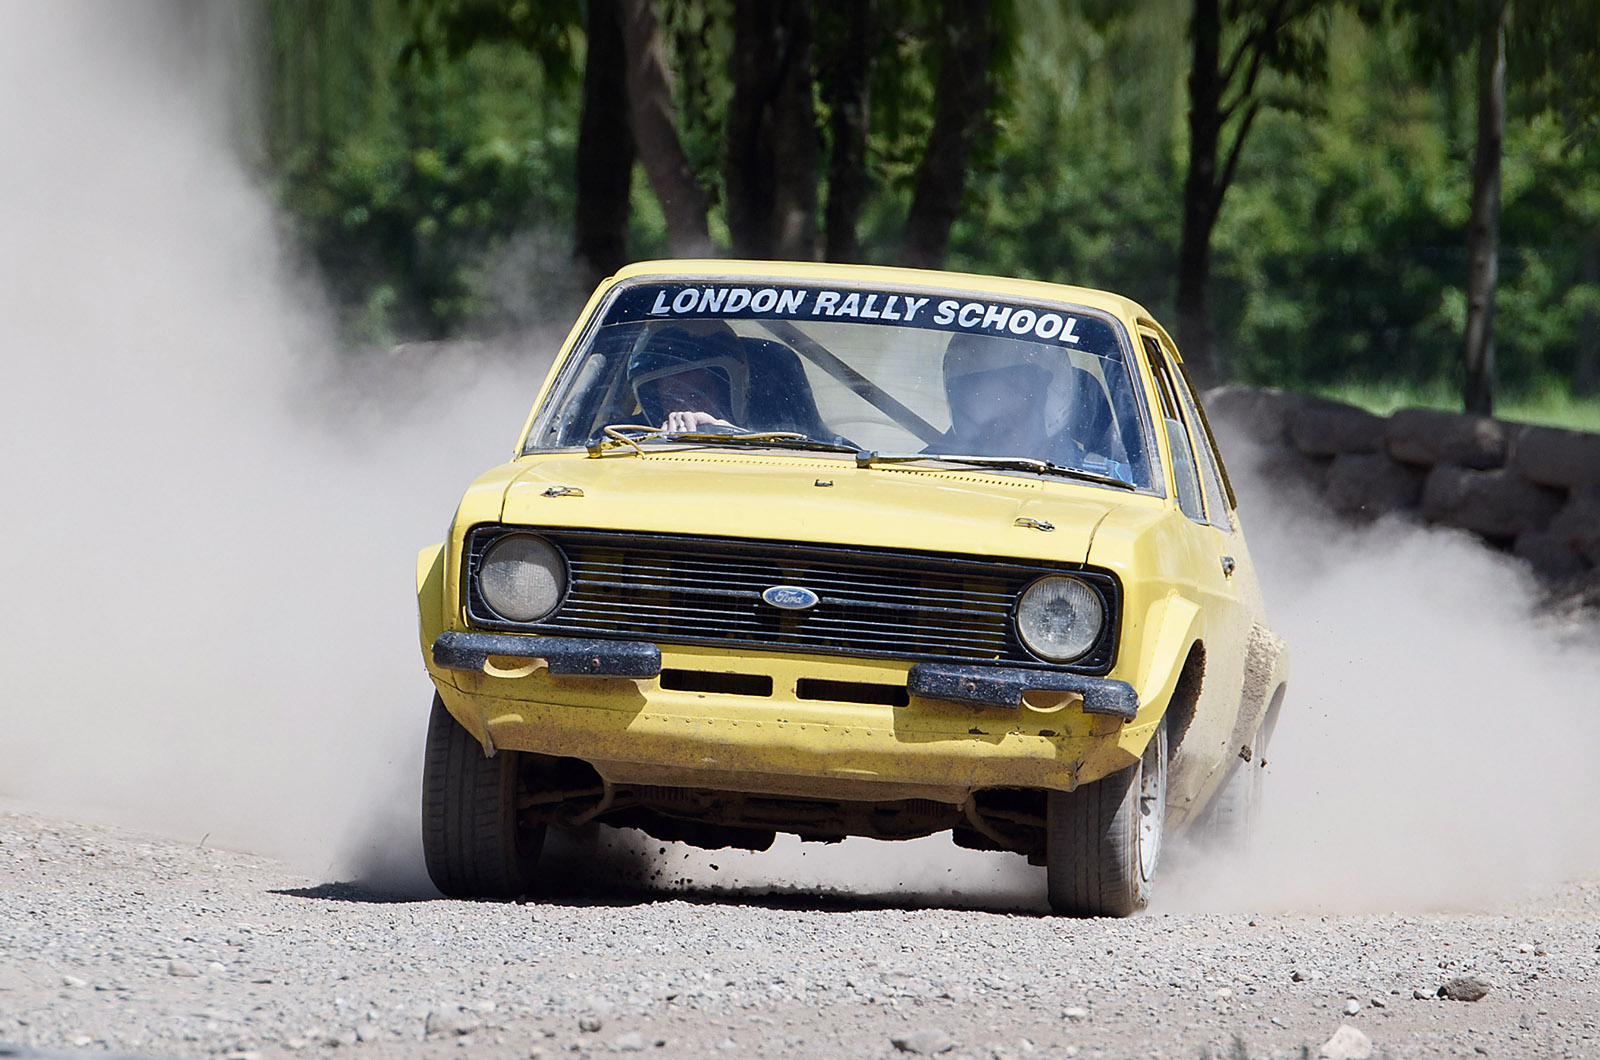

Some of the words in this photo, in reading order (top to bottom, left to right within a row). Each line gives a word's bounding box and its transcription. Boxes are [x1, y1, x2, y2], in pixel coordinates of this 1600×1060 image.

[650, 288, 807, 314] LONDON
[811, 291, 930, 321] RALLY
[933, 300, 1080, 344] SCHOOL
[774, 590, 805, 604] Ford
